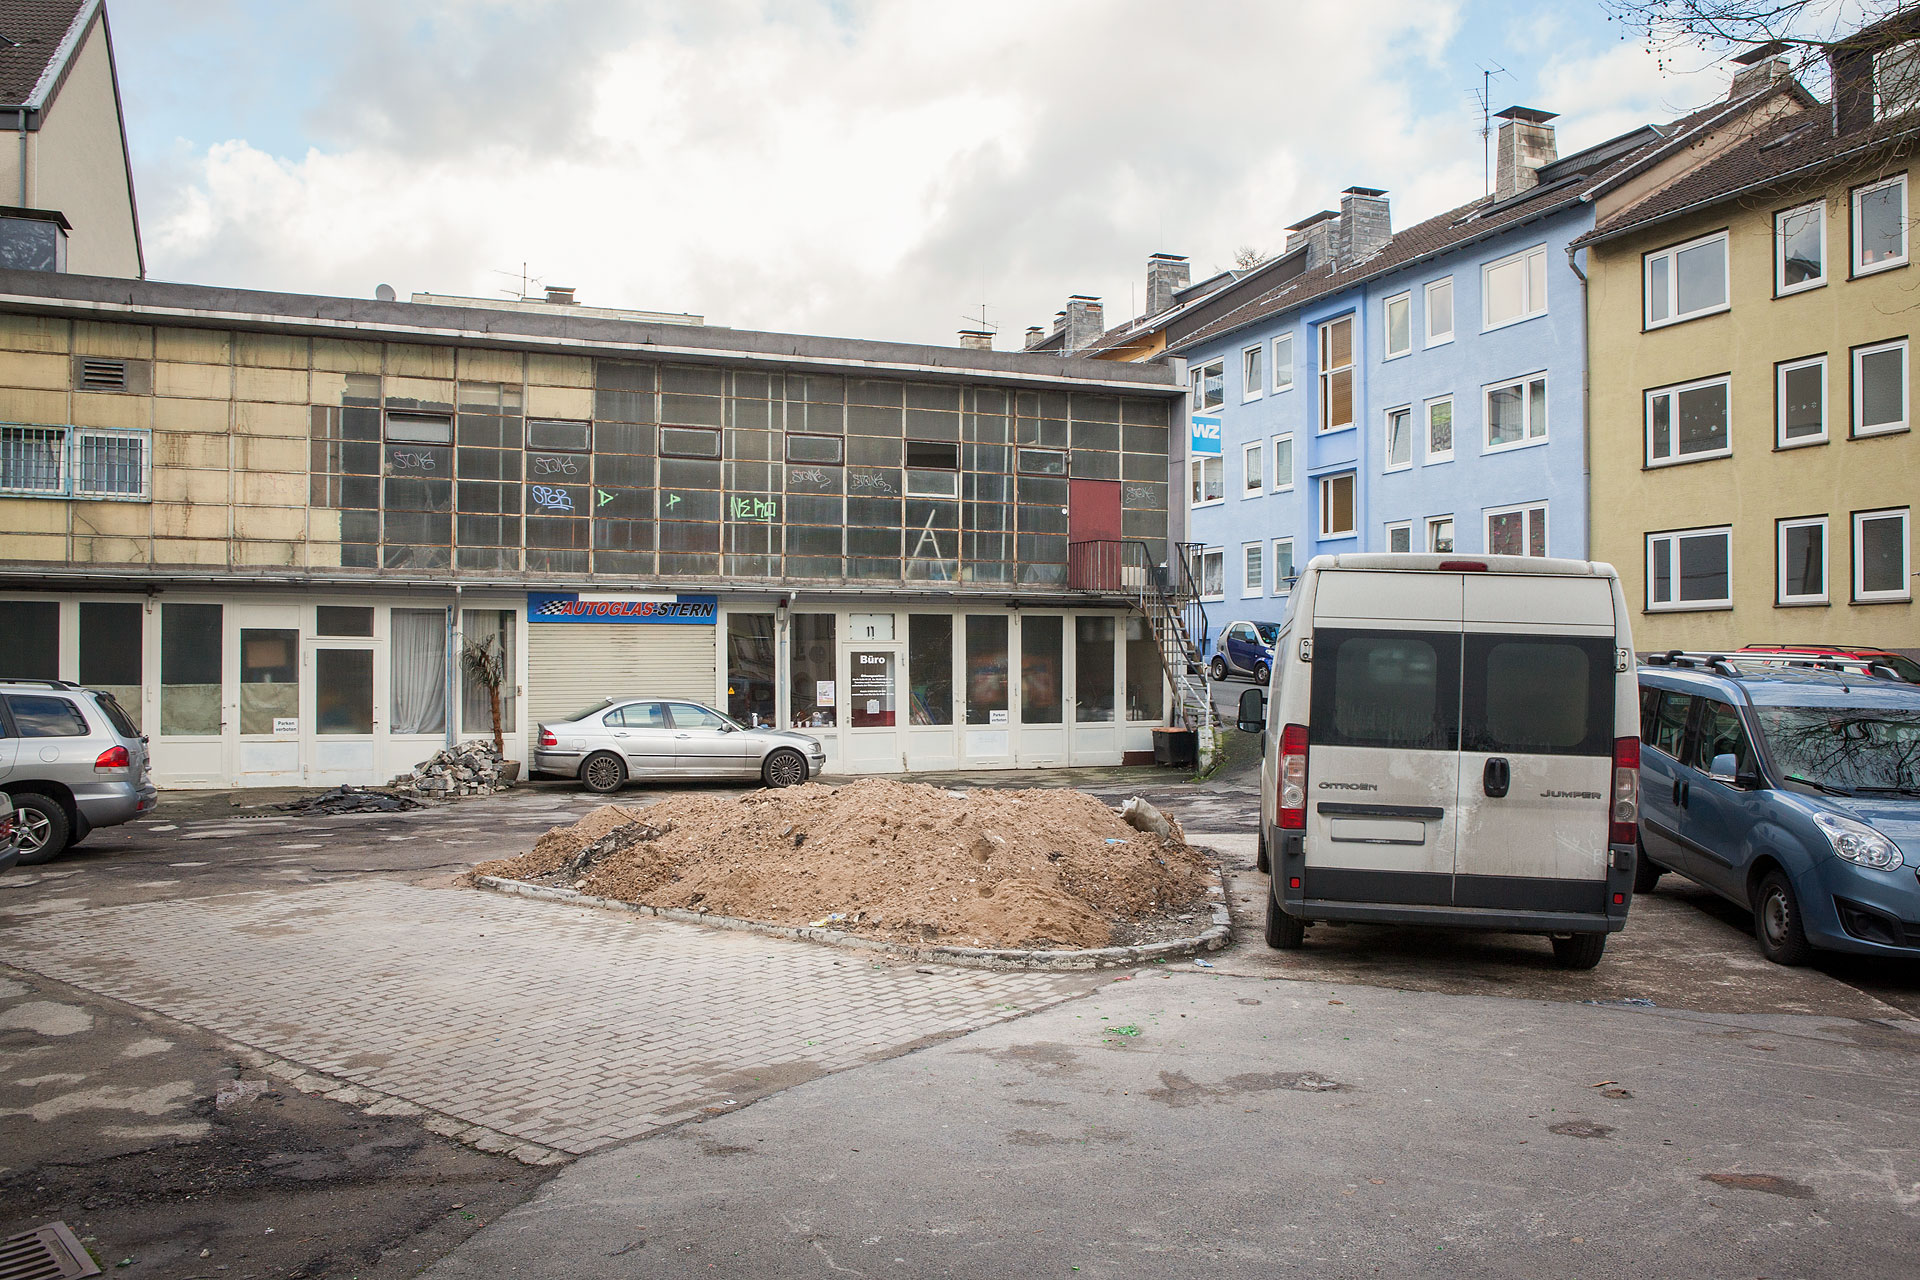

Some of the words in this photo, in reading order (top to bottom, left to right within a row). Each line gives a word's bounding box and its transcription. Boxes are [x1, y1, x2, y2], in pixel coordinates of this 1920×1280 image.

[1192, 423, 1220, 439] WZ
[730, 496, 776, 519] NERO
[560, 601, 714, 616] AUTOGLAS-STERN
[866, 626, 875, 637] 11
[860, 655, 886, 664] Büro
[1540, 789, 1602, 800] JUMPER
